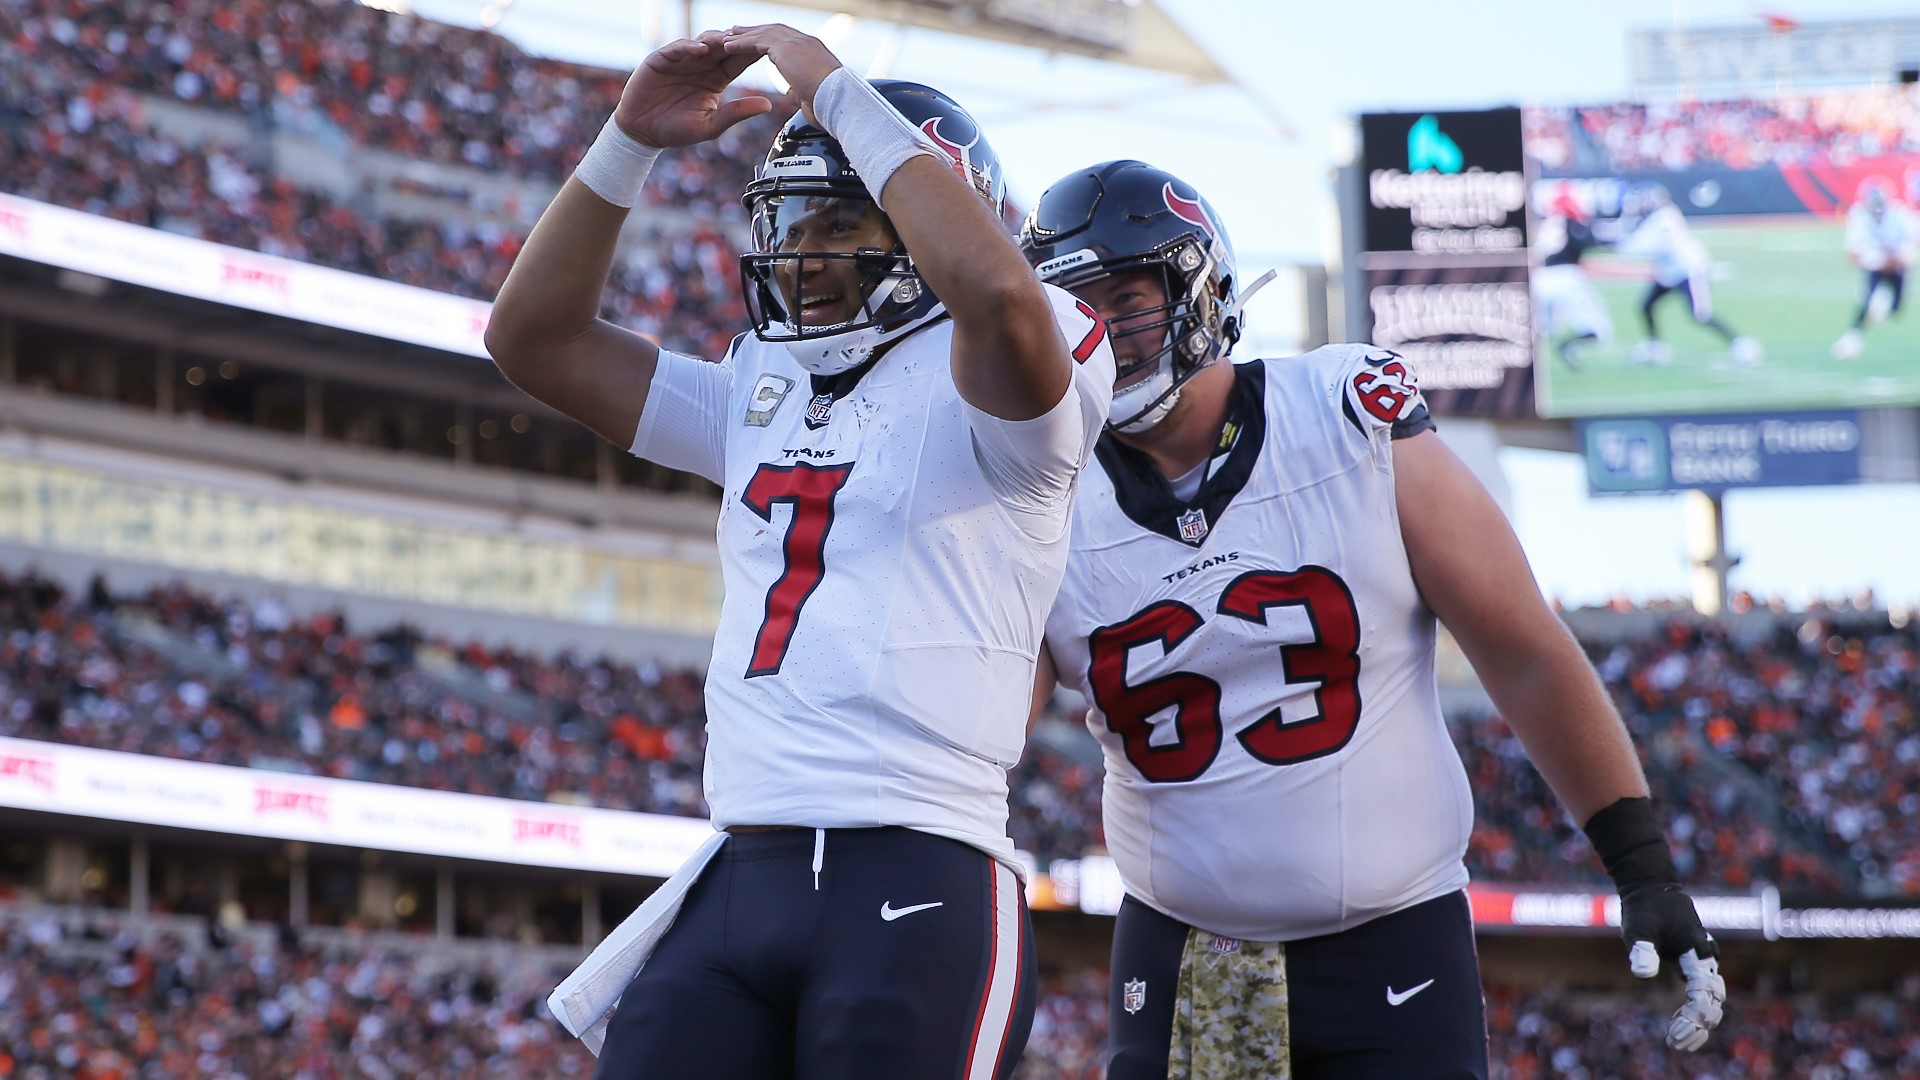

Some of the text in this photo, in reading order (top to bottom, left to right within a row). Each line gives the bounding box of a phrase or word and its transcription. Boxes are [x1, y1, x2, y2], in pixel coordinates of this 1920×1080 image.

[773, 160, 813, 169] TEXANS
[1041, 255, 1083, 272] TEXANS
[1071, 299, 1107, 365] 7
[748, 376, 788, 413] C
[810, 404, 831, 420] NFL
[782, 447, 836, 458] TEANS
[1184, 522, 1204, 537] NFL
[740, 460, 856, 679] 7
[1162, 551, 1240, 584] TEXANS
[1087, 565, 1362, 783] 63
